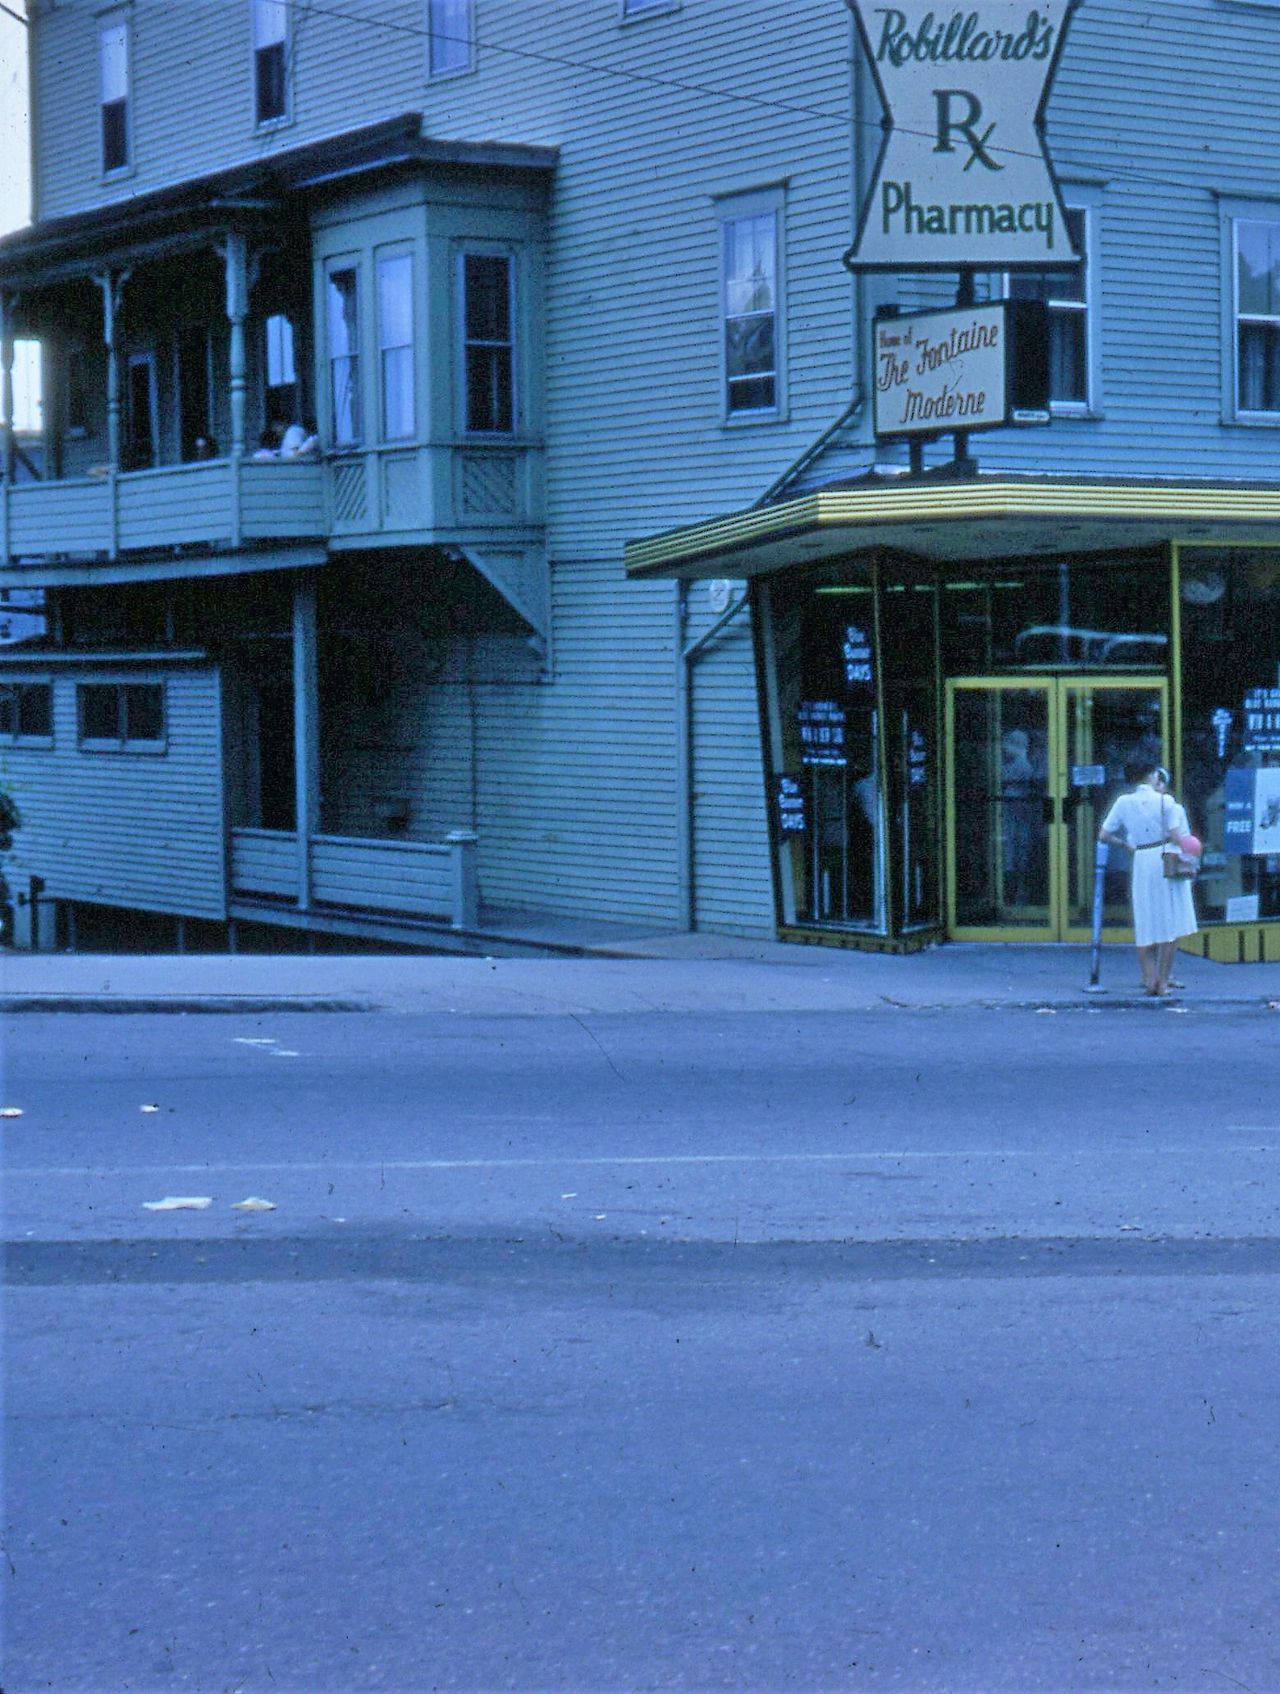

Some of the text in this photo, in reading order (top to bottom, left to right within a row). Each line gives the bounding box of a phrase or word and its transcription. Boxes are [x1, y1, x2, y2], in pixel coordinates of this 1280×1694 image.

[874, 8, 1054, 67] Robillard's
[881, 181, 1054, 249] Pharmacy
[877, 321, 999, 391] The Fontaine
[899, 384, 986, 424] Moderne
